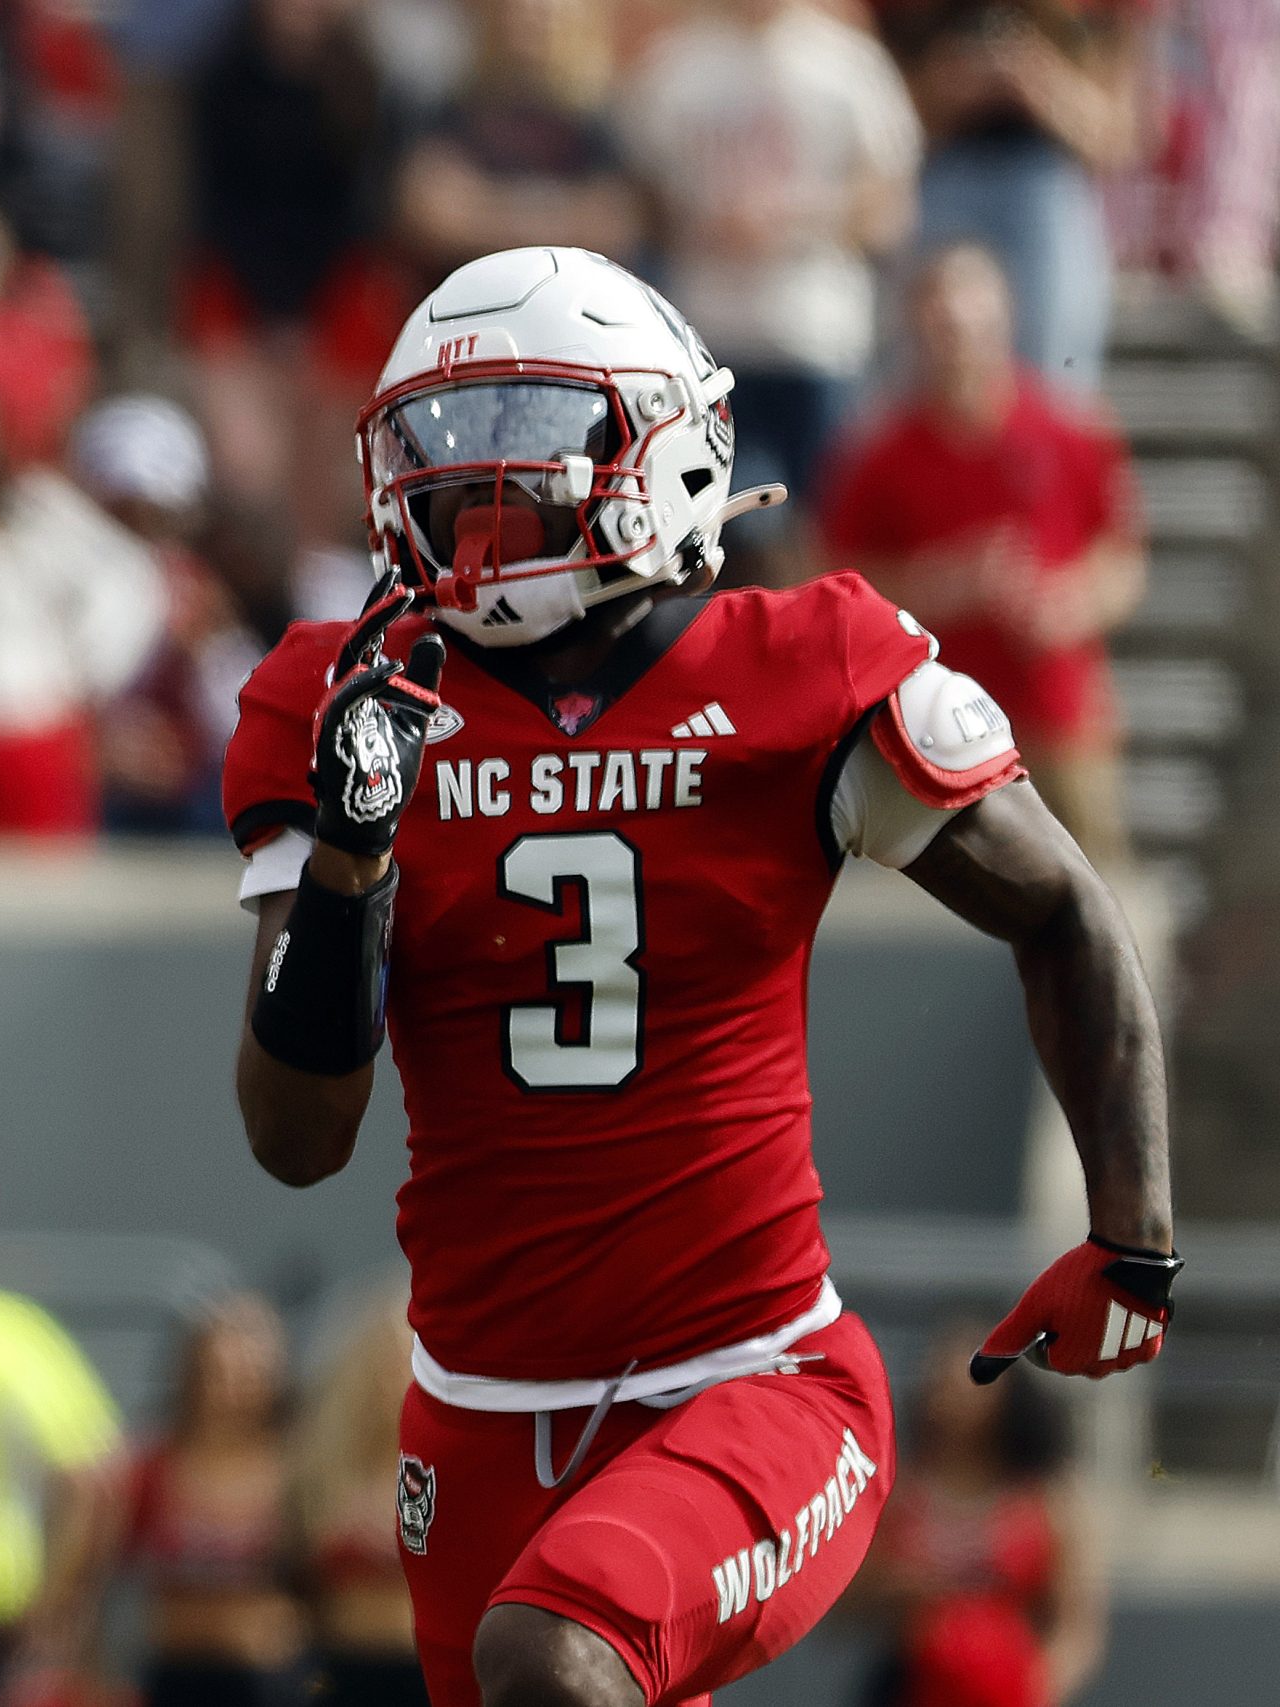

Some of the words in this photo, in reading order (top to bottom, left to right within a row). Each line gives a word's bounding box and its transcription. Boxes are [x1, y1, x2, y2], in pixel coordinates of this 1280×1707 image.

[436, 757, 511, 820] NC
[530, 749, 708, 815] STATE
[499, 830, 646, 1091] 3
[712, 1426, 877, 1625] WOLFPACK
